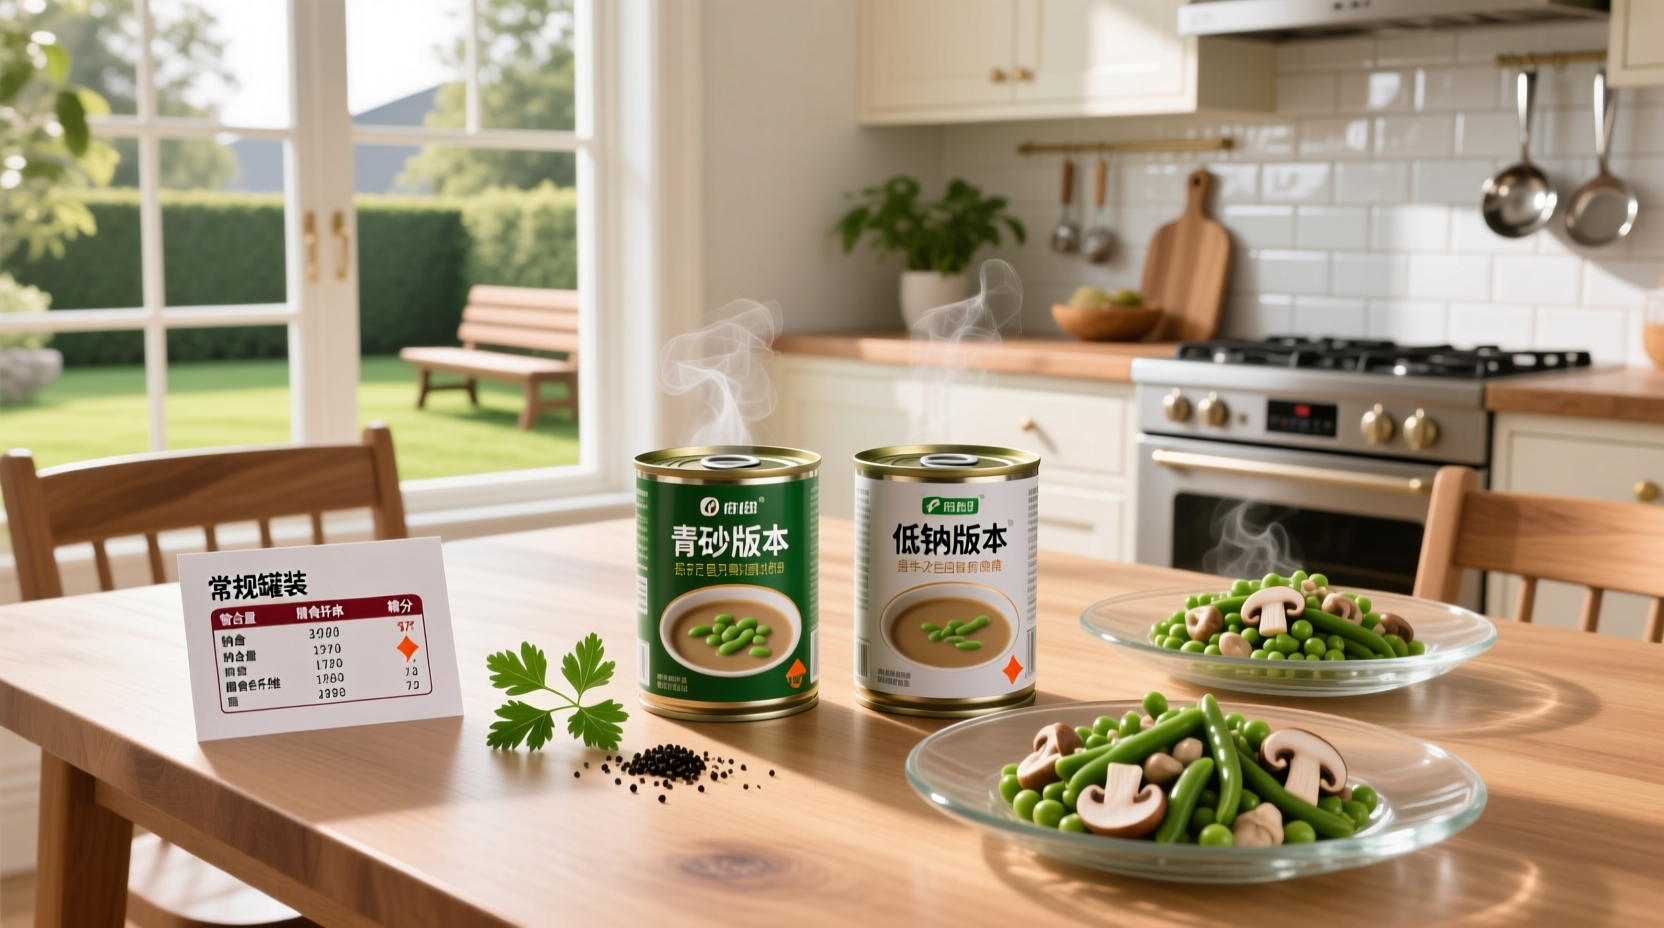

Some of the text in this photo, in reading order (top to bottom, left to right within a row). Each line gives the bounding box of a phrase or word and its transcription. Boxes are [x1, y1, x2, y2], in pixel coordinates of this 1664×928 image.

[671, 523, 789, 558] 青砂版本
[892, 522, 1007, 556] 低钠版本
[208, 570, 308, 601] 常规罐装
